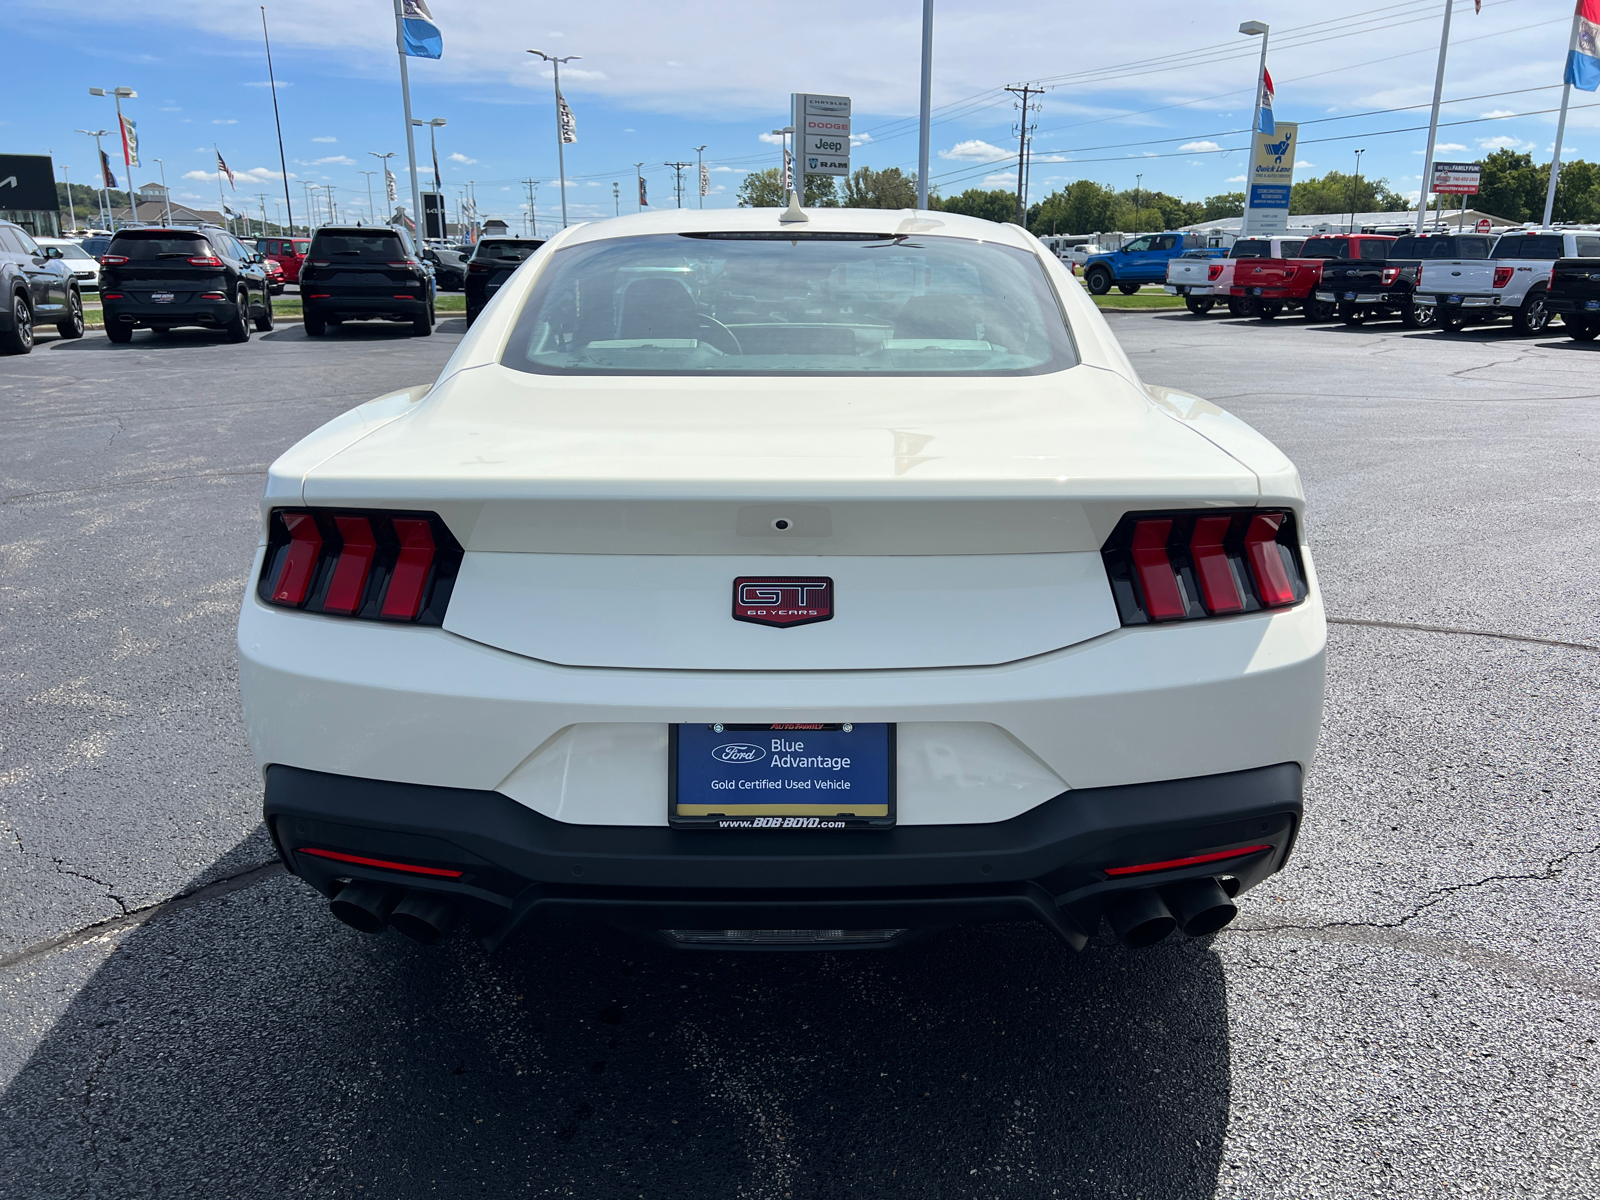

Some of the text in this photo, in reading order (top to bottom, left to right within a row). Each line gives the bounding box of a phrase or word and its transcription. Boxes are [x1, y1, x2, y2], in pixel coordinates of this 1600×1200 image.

[560, 103, 574, 144] TRUCKS
[808, 121, 849, 131] DODGE
[815, 138, 842, 152] Jeep
[820, 161, 848, 169] RAM
[1255, 165, 1275, 173] Quick
[738, 582, 827, 606] GT
[771, 738, 804, 752] Blue
[721, 745, 756, 760] Ford
[770, 754, 851, 771] Advantage
[711, 779, 851, 790] Gold Certified Used Vehicle
